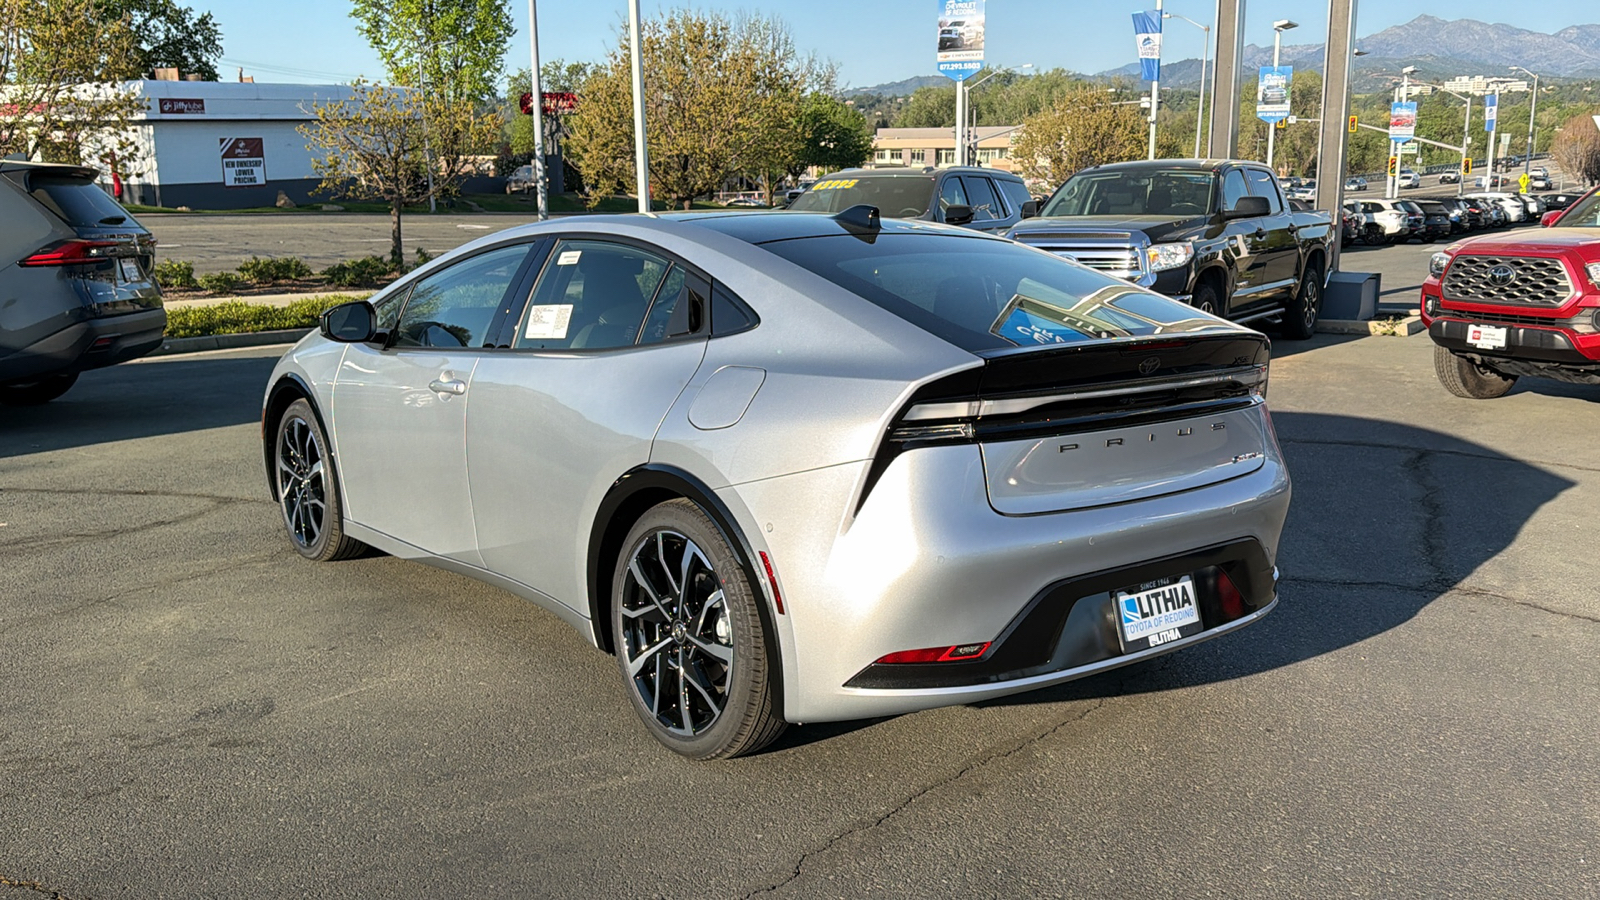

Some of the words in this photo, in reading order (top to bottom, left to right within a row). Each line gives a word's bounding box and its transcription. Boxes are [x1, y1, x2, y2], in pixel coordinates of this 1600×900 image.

[945, 2, 976, 10] CHEVROLET
[225, 160, 236, 168] NEW
[236, 160, 262, 168] OWNERSHIP
[234, 176, 257, 184] PRICING
[1058, 422, 1226, 453] PRIUS
[1140, 580, 1157, 591] SINCE
[1136, 585, 1192, 619] LITHIA
[1125, 620, 1153, 634] TOYOTA
[1153, 616, 1163, 628] OF
[1165, 607, 1195, 624] REDDING
[1156, 627, 1182, 645] LITHIA
